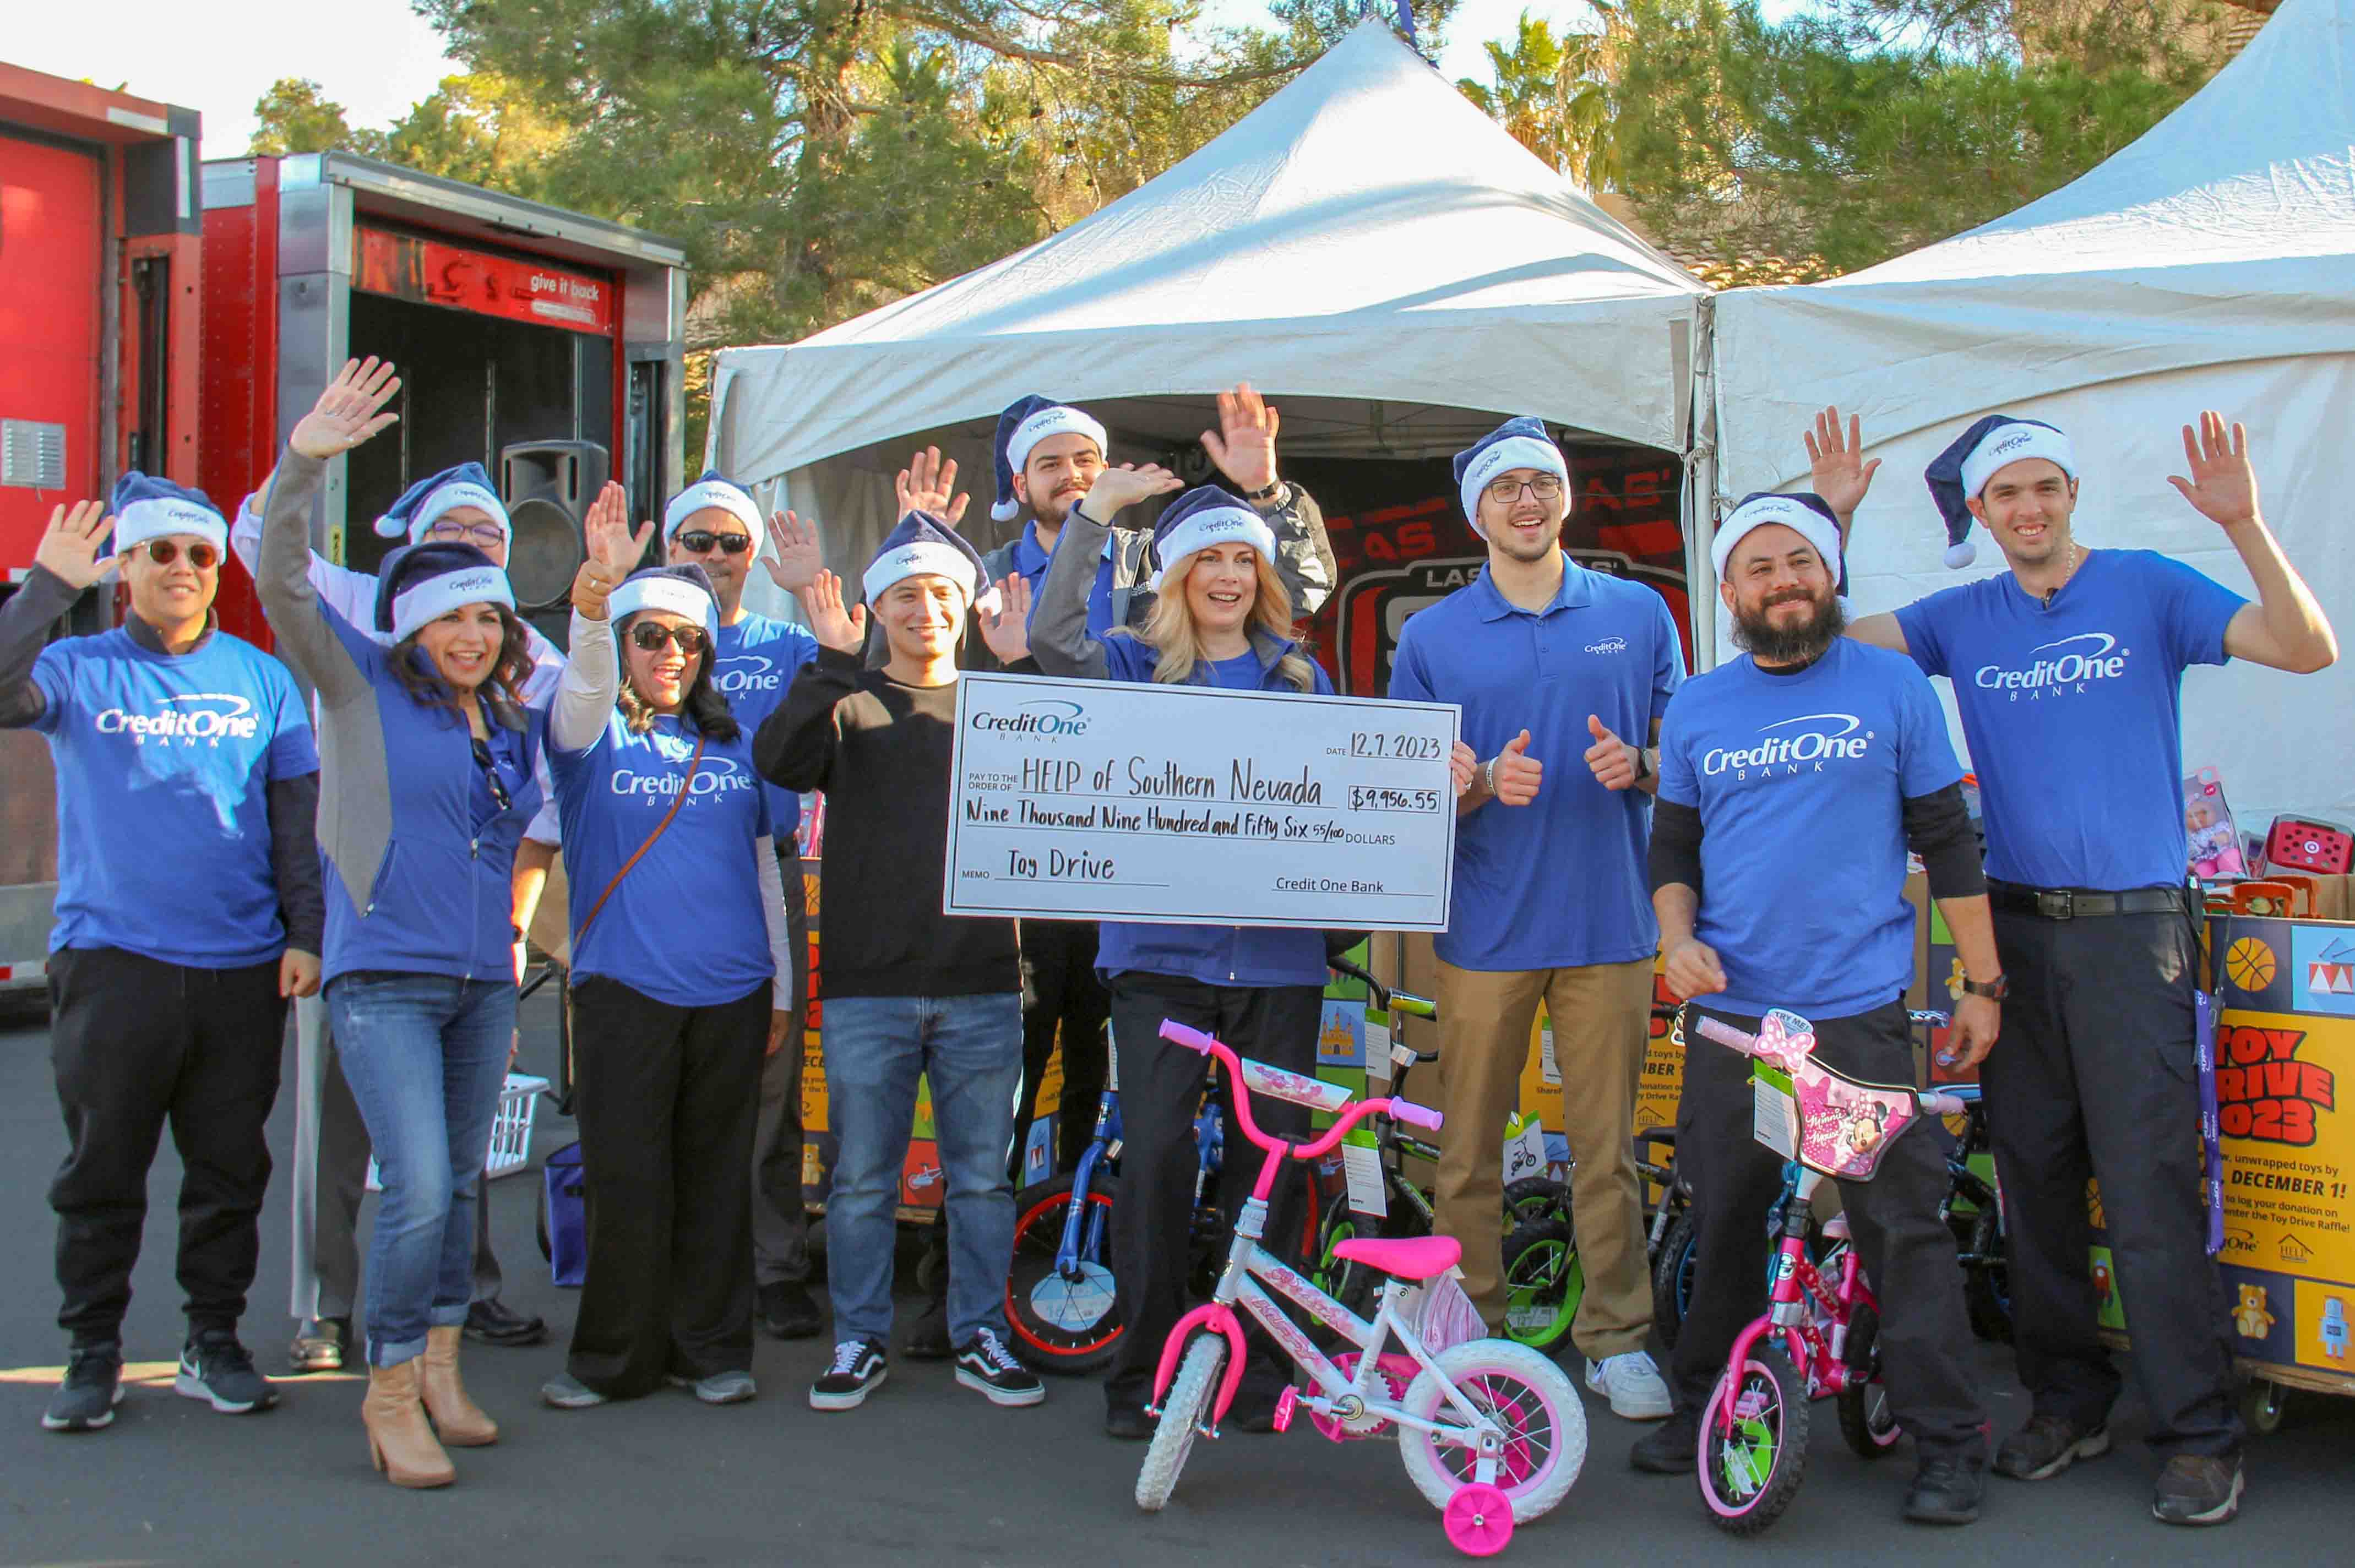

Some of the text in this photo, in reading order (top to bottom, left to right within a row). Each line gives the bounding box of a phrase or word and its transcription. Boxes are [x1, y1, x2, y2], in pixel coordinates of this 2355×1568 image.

[531, 273, 599, 302] give it back
[1975, 654, 2124, 690] CreditOne
[2010, 683, 2085, 702] BANK
[96, 709, 258, 738] CreditOne
[972, 711, 1087, 736] CreditOne
[999, 734, 1058, 744] BANK
[1326, 747, 1347, 756] DATE
[1703, 732, 1868, 776] CreditOne
[969, 772, 1018, 783] PAY TO THE
[1023, 756, 1322, 805] HELP of Southern Nevada
[1738, 761, 1824, 781] BANK
[969, 782, 1012, 792] ORDER OF
[966, 796, 1345, 842] Nine Thousand Nine Hundred and Fifty Six 55/100
[1345, 833, 1395, 845] DOLLARS
[961, 870, 990, 879] MEMO
[1008, 848, 1115, 880] Toy Drive
[1276, 876, 1384, 893] Credit One Bank
[1775, 1011, 1789, 1021] TRY
[2215, 1060, 2335, 1113] RIVE
[2197, 1098, 2317, 1147] 023
[2234, 1154, 2297, 1171] unwrapped
[2299, 1161, 2322, 1175] toys
[2325, 1162, 2339, 1178] by
[2231, 1169, 2347, 1199] DECEMBER 1!
[2237, 1195, 2252, 1208] log
[2254, 1199, 2277, 1212] your
[2278, 1200, 2323, 1217] donation
[2325, 1210, 2338, 1218] on
[2251, 1211, 2269, 1221] the
[2270, 1213, 2288, 1226] Toy
[2289, 1216, 2317, 1228] Drive
[2318, 1219, 2350, 1233] Raffle!
